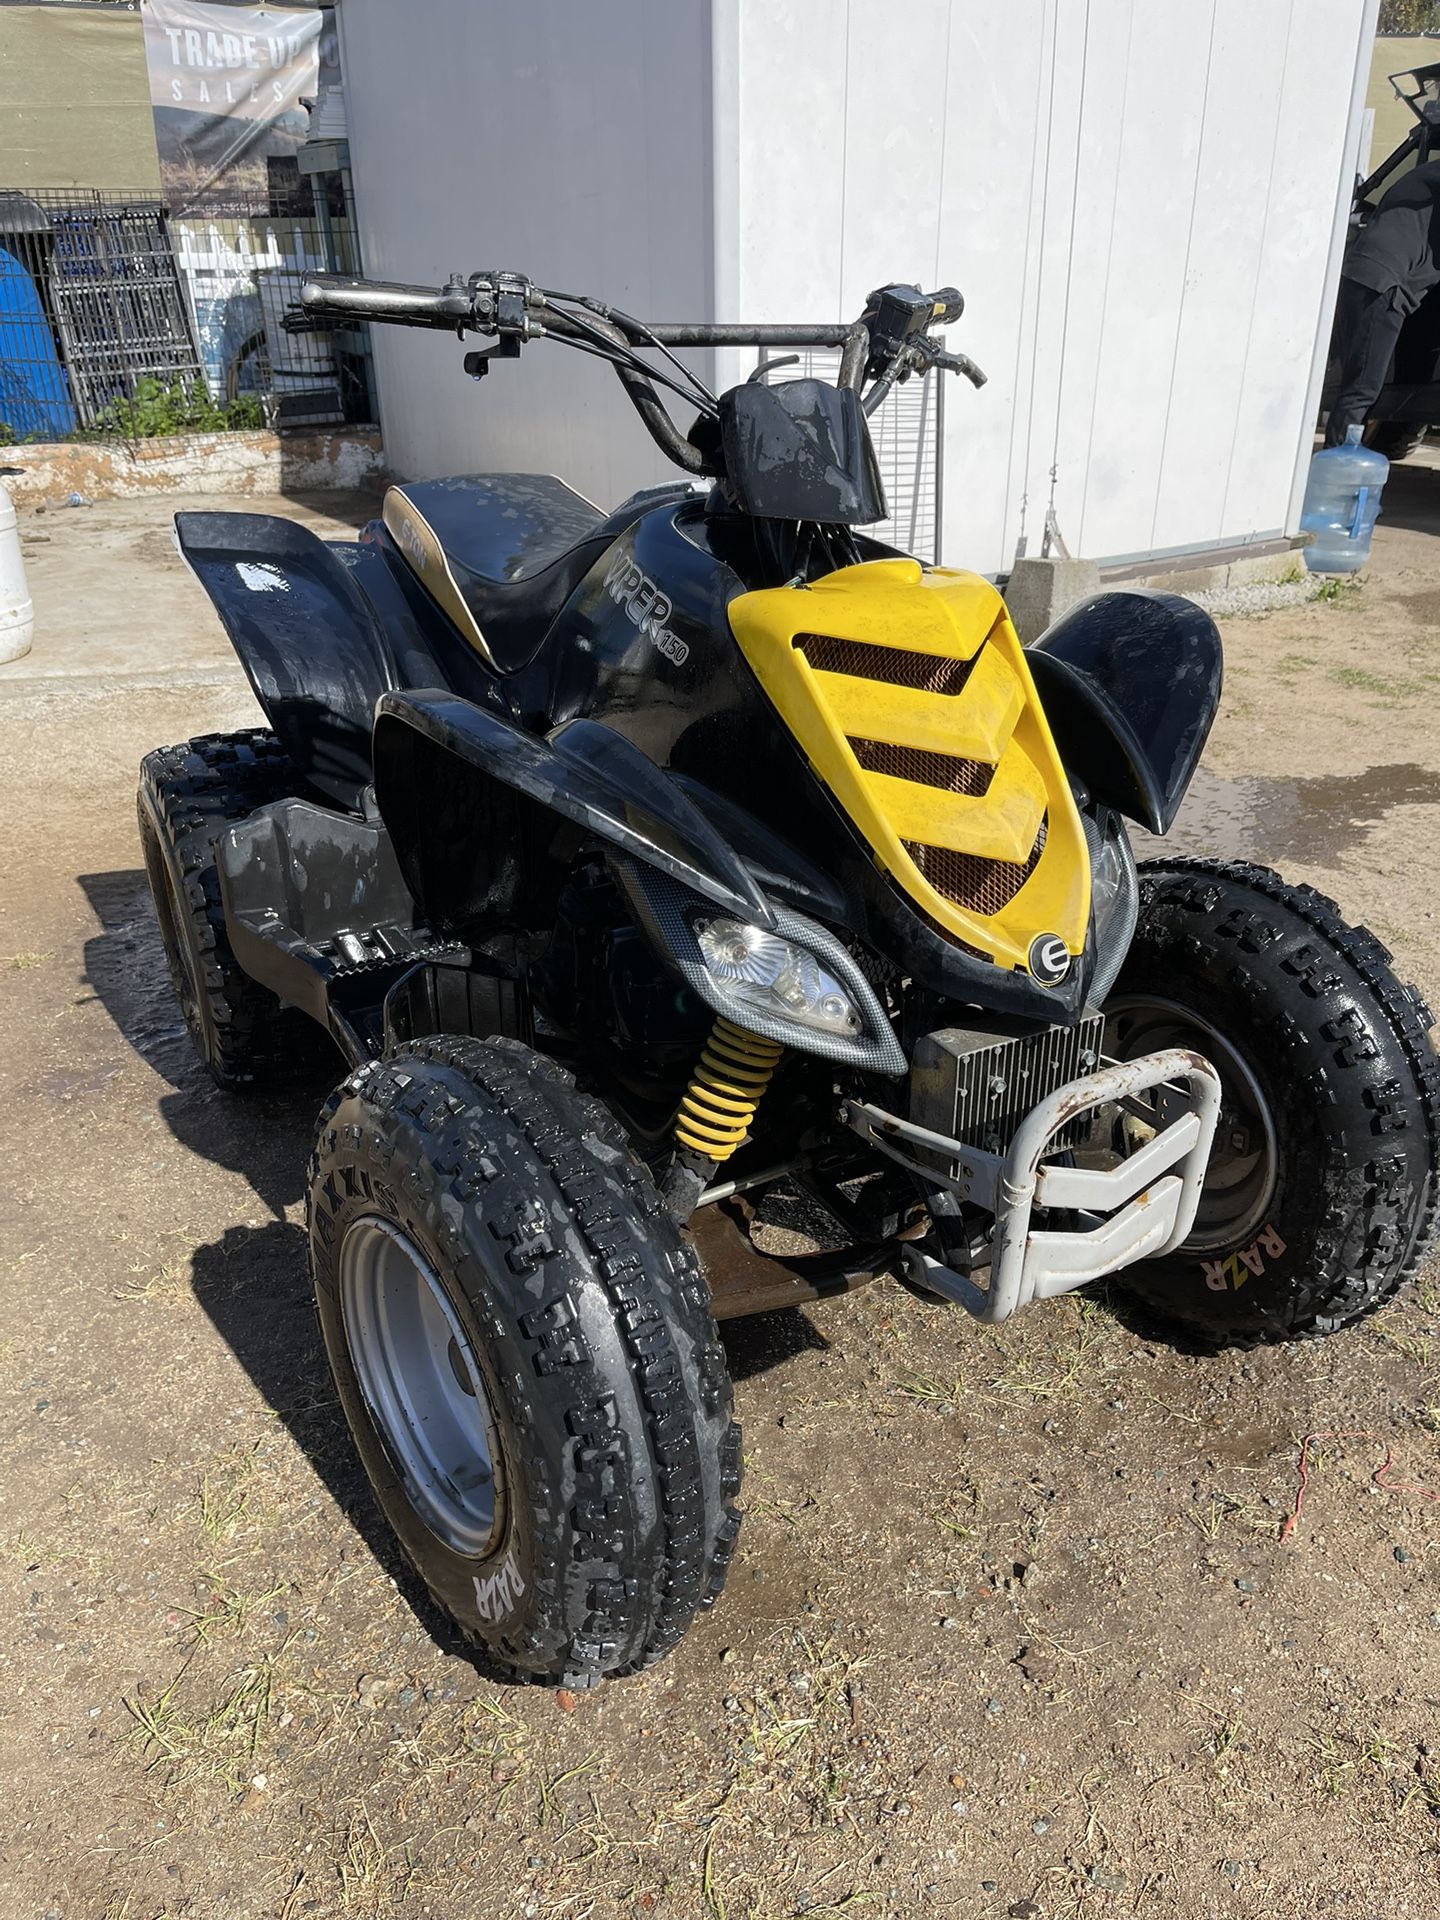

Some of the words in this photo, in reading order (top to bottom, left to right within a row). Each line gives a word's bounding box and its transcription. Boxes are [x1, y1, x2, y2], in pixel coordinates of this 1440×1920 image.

[165, 28, 260, 70] TRADE
[266, 34, 300, 70] UP
[171, 78, 284, 104] SALES
[603, 548, 673, 645] VIPER
[659, 631, 689, 665] 150
[1200, 1223, 1287, 1291] RAZR
[472, 1549, 525, 1623] RAZR
